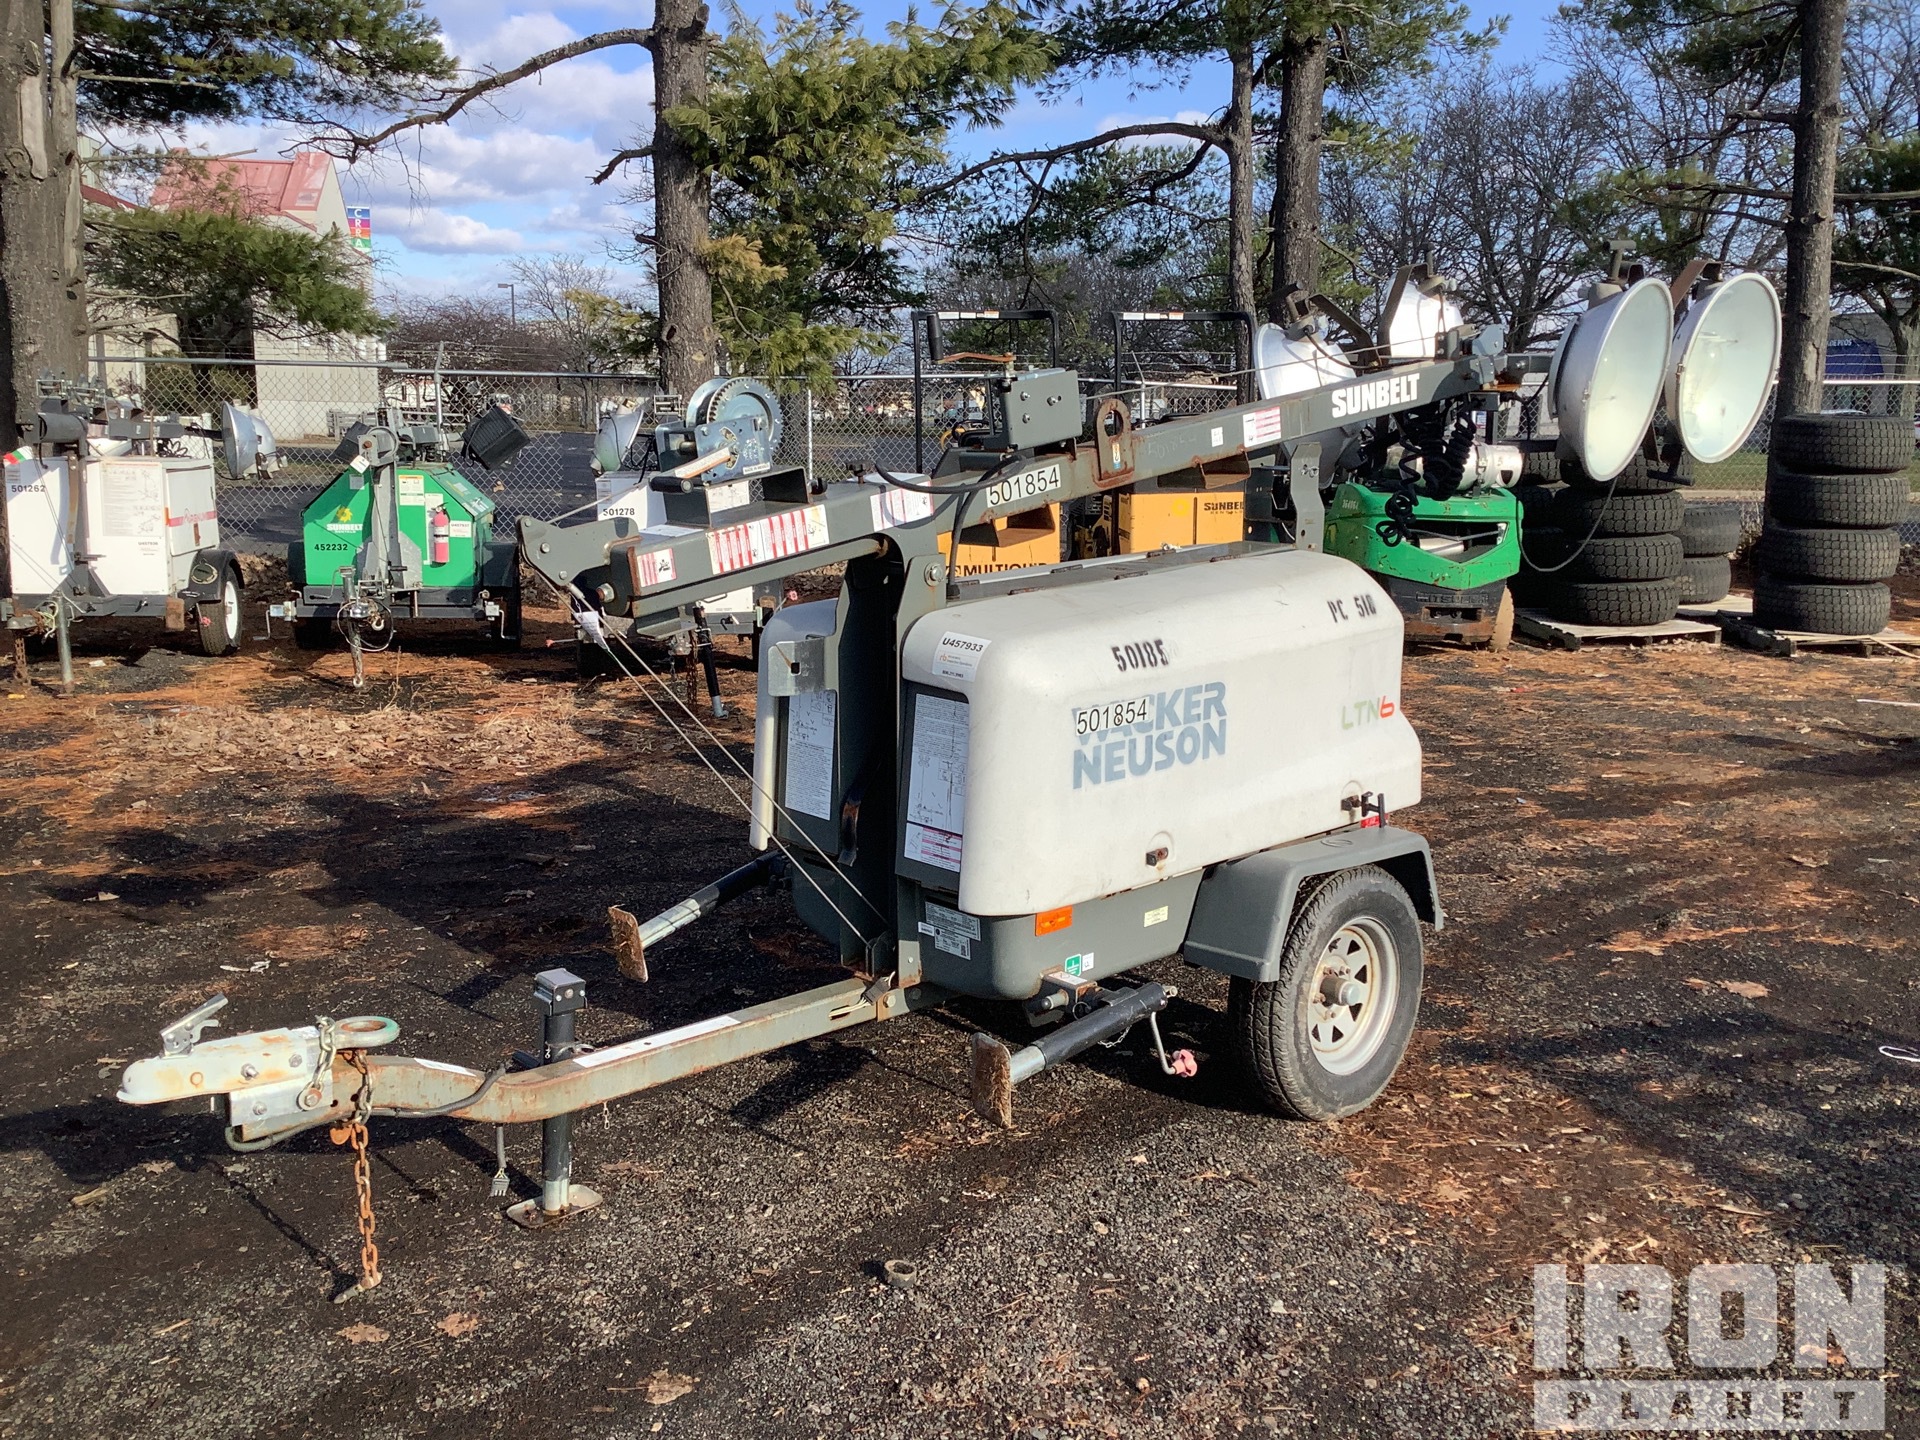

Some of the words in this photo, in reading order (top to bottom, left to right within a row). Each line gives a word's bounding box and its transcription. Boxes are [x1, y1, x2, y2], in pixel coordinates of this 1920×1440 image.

[1331, 372, 1420, 419] SUNBELT
[11, 484, 46, 493] 501262
[988, 466, 1060, 506] 501854
[603, 508, 635, 516] 501278
[1327, 600, 1348, 623] PC
[942, 637, 984, 652] U457933
[1076, 698, 1148, 735] 501854
[1342, 695, 1395, 730] LTN6
[1072, 718, 1227, 789] NEUSON
